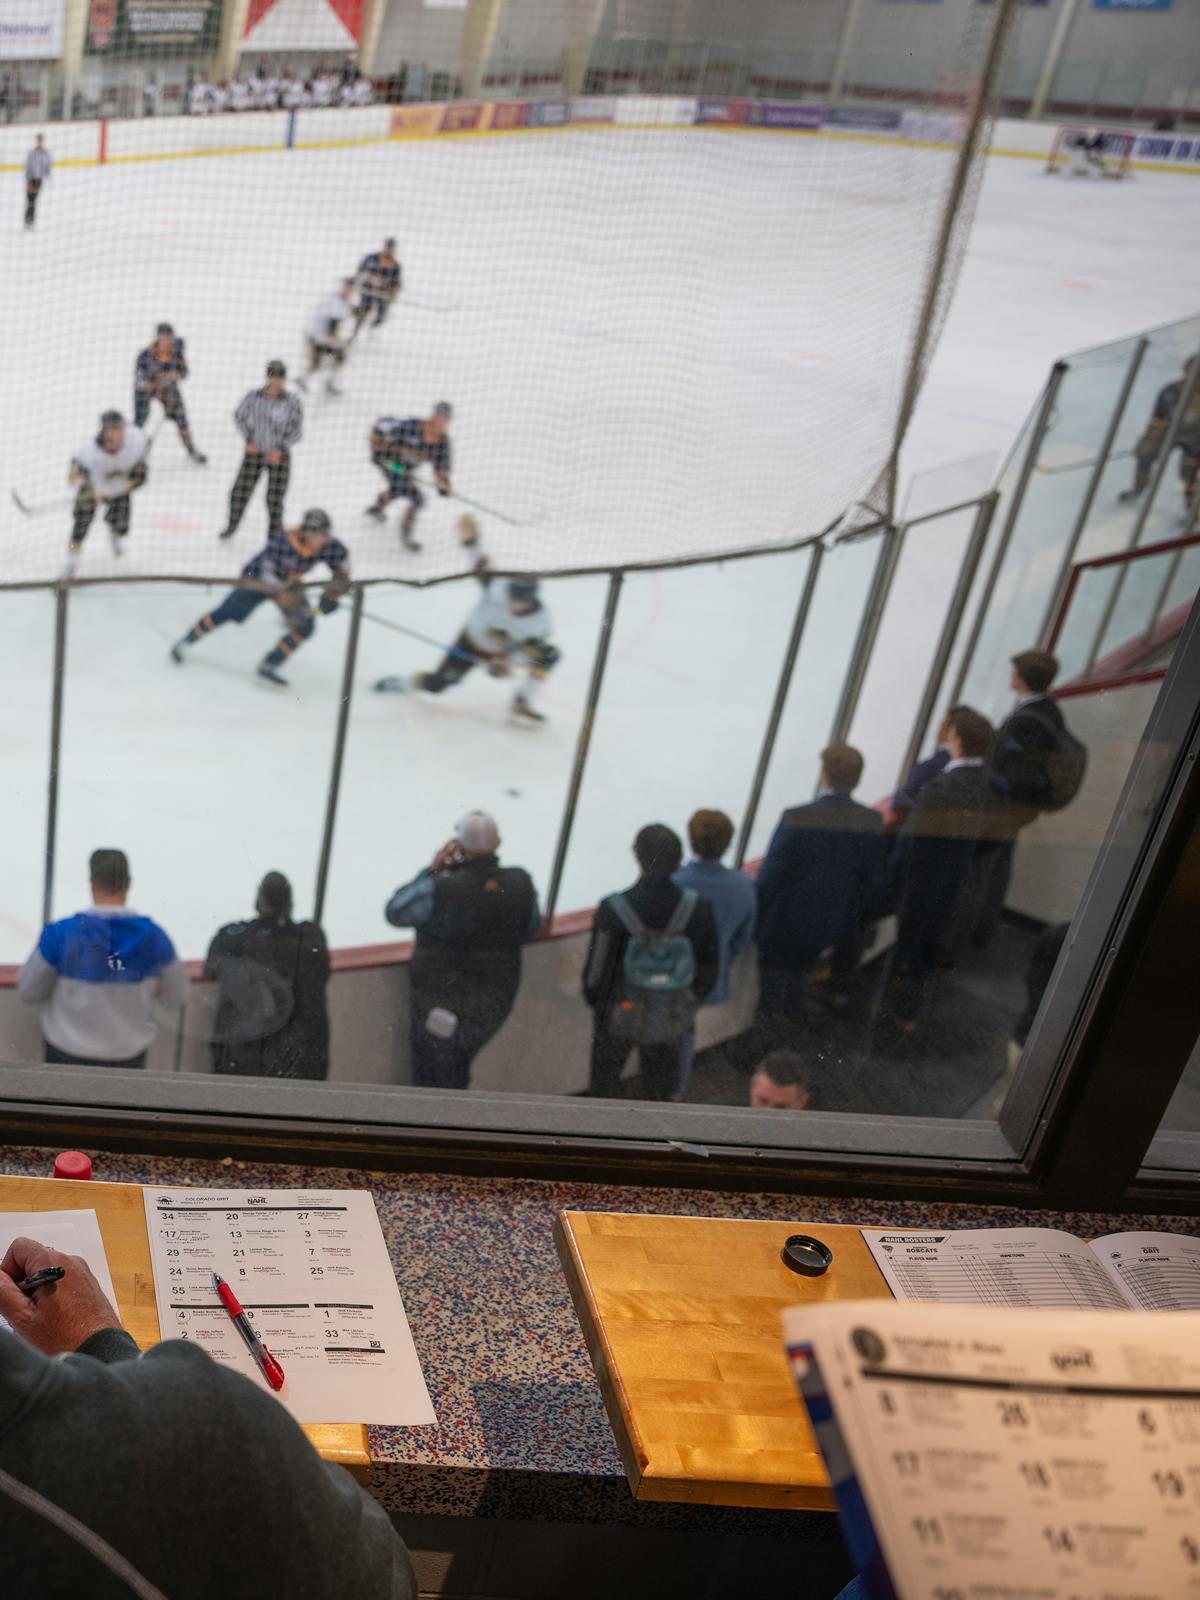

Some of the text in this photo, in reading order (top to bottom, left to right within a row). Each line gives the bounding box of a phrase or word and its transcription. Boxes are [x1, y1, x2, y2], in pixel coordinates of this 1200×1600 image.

[247, 1197, 267, 1205] NAHL
[233, 1249, 245, 1257] 21
[240, 1268, 246, 1276] 8
[172, 1286, 186, 1294] 55
[179, 1311, 185, 1319] 4
[247, 1311, 254, 1319] 9
[324, 1310, 330, 1318] 1
[181, 1331, 188, 1339] 2
[325, 1330, 339, 1338] 33
